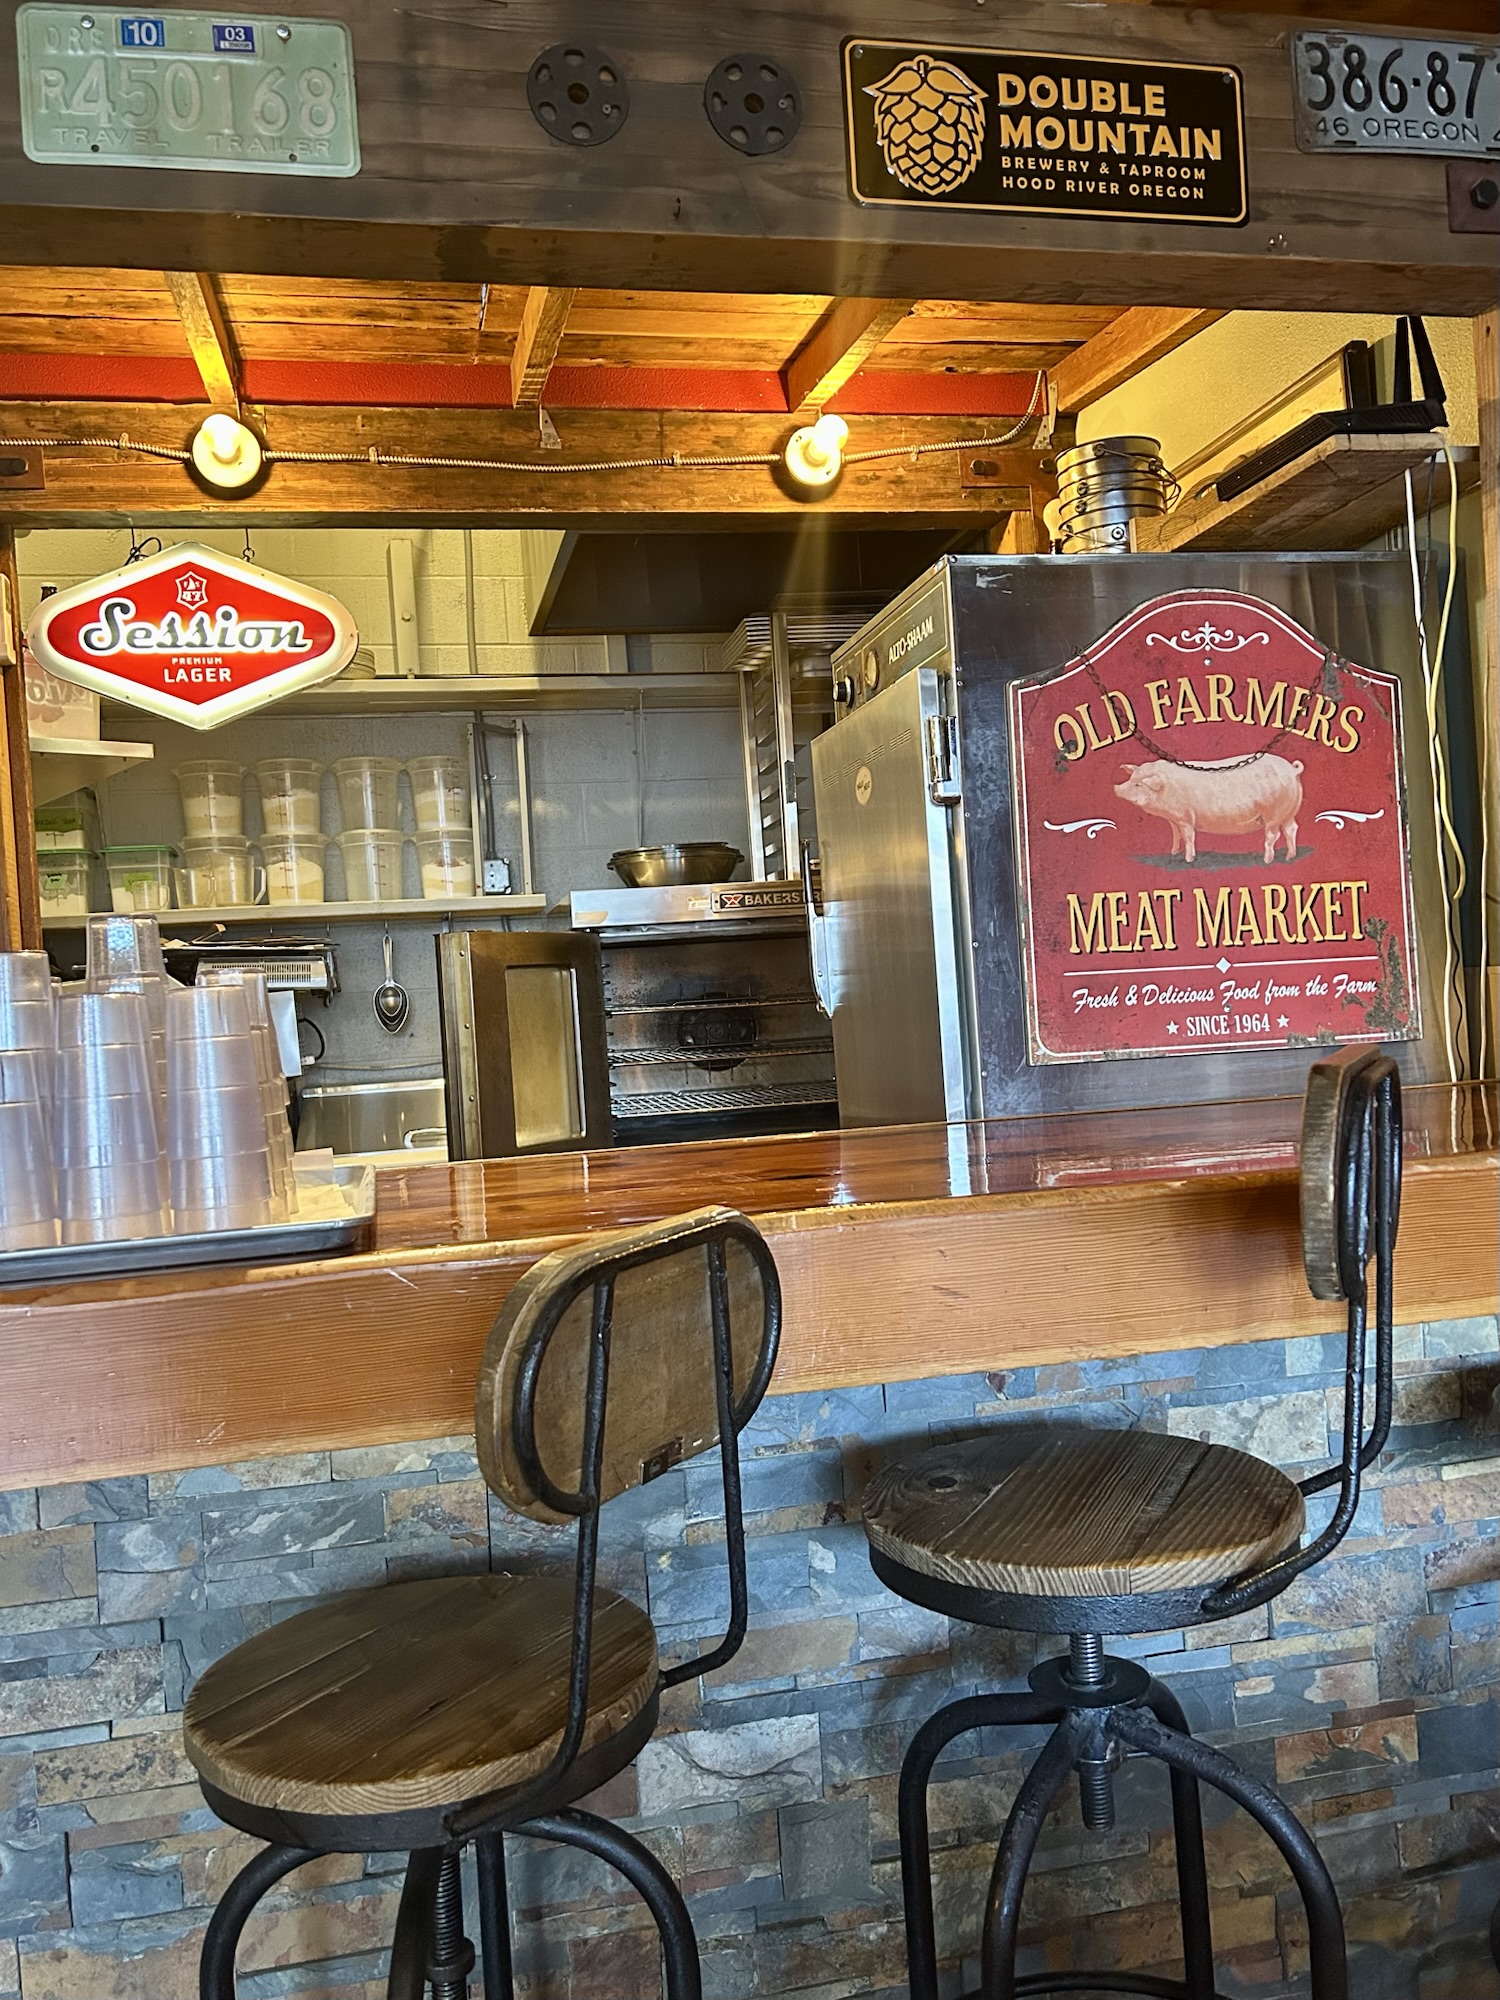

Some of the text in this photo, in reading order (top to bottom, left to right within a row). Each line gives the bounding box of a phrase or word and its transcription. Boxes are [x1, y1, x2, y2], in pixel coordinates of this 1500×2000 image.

[127, 21, 158, 46] 10
[224, 27, 246, 41] 03
[997, 73, 1167, 117] DOUBLE
[52, 127, 332, 157] TRAVEL TRAILER
[1000, 114, 1222, 161] MOUNTAIN
[1316, 116, 1349, 137] 46
[1363, 117, 1480, 143] OREGON
[1001, 156, 1206, 180] BREWERY & TAPROOM
[1002, 176, 1204, 199] HOOD RIVER OREGON
[81, 600, 311, 653] Session
[889, 615, 933, 665] ALTO-SHAAM
[172, 657, 222, 665] PREMIUM
[164, 668, 232, 683] LAGER
[1053, 674, 1365, 761] OLD FARMERS
[745, 892, 801, 906] BAKERS
[1066, 880, 1370, 956] MEAT MARKET
[1072, 974, 1378, 1013] Fresh & Delicious Food from the Farm
[1186, 1013, 1271, 1037] SINCE 1964
